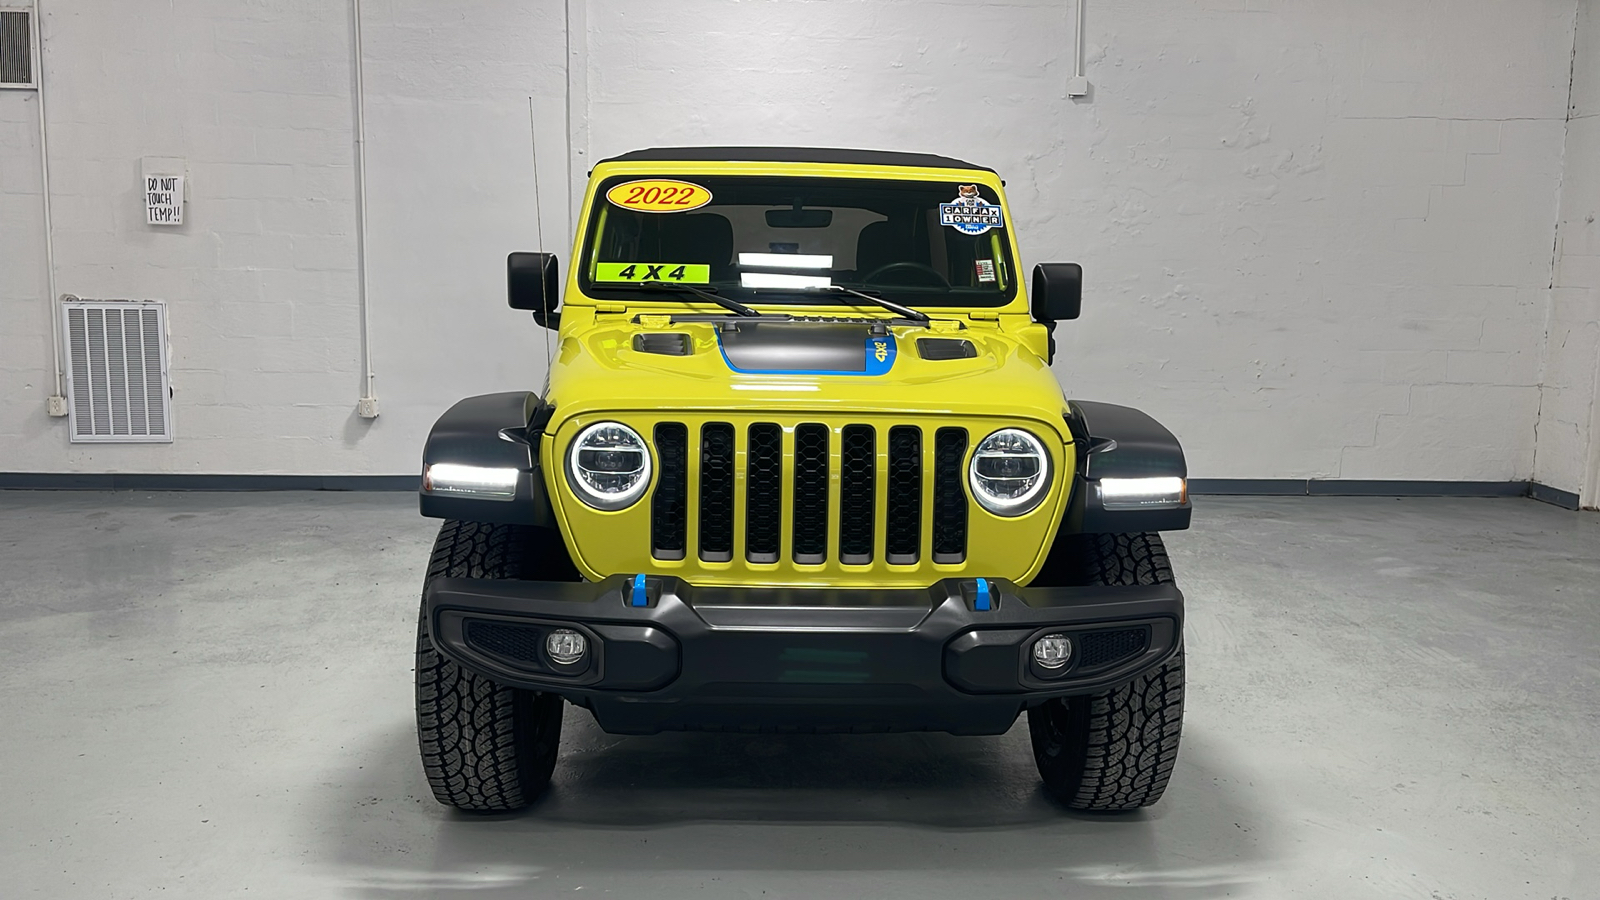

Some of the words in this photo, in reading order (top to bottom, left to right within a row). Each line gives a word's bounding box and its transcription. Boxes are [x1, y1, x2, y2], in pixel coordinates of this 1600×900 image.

[148, 178, 158, 191] DO
[161, 178, 178, 192] NOT
[147, 193, 172, 205] TOUCH
[624, 187, 695, 205] 2022
[148, 206, 180, 222] TEMP!!
[944, 207, 997, 216] CARFAX
[954, 215, 998, 224] OWNER
